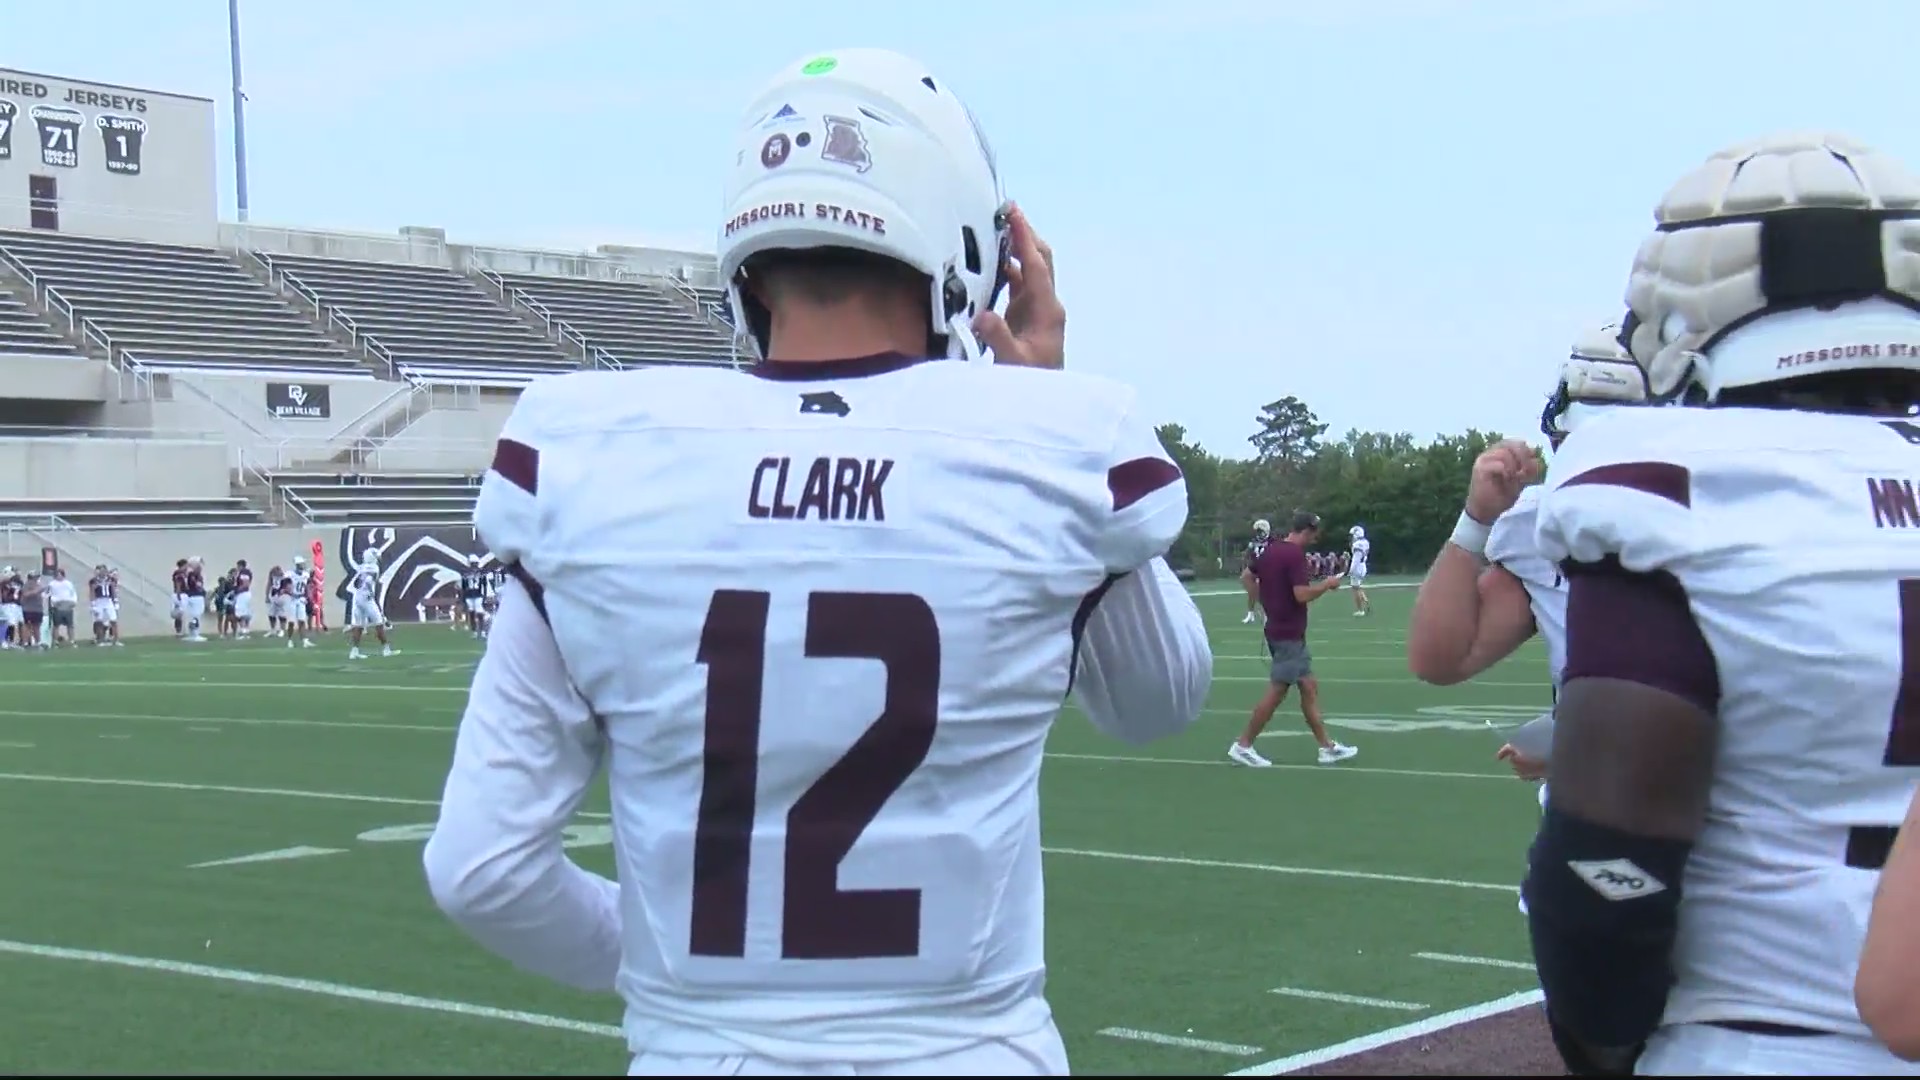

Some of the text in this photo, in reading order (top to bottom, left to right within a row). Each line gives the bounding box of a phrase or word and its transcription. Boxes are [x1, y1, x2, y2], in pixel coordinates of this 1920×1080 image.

[64, 88, 147, 113] JERSEYS
[45, 126, 74, 150] 71
[111, 119, 145, 132] SMITH
[116, 135, 128, 157] 1
[725, 203, 886, 237] MISSOURI STATE
[1776, 344, 1880, 369] MISSOURI
[276, 405, 321, 416] BEAR VILLAGE
[748, 457, 895, 521] CLARK
[689, 590, 940, 960] 12
